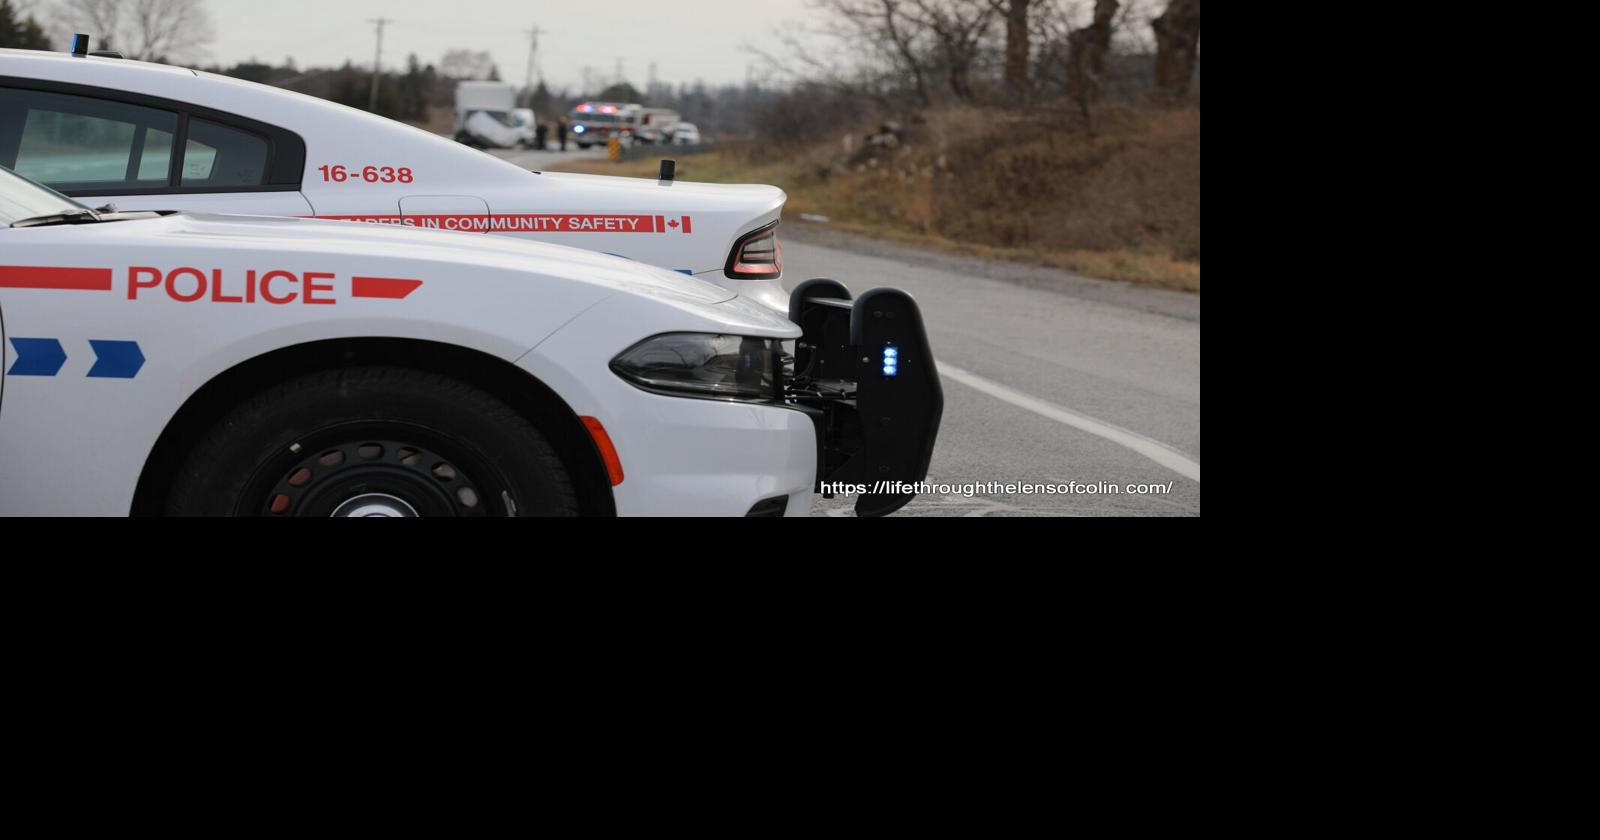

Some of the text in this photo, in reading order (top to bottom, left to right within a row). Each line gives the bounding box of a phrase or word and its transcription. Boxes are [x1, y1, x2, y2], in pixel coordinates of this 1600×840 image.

[319, 165, 413, 183] 16-638
[421, 218, 440, 229] IN
[444, 217, 563, 230] COMMUNITY
[568, 217, 639, 230] SAFETY
[127, 266, 336, 305] POLICE
